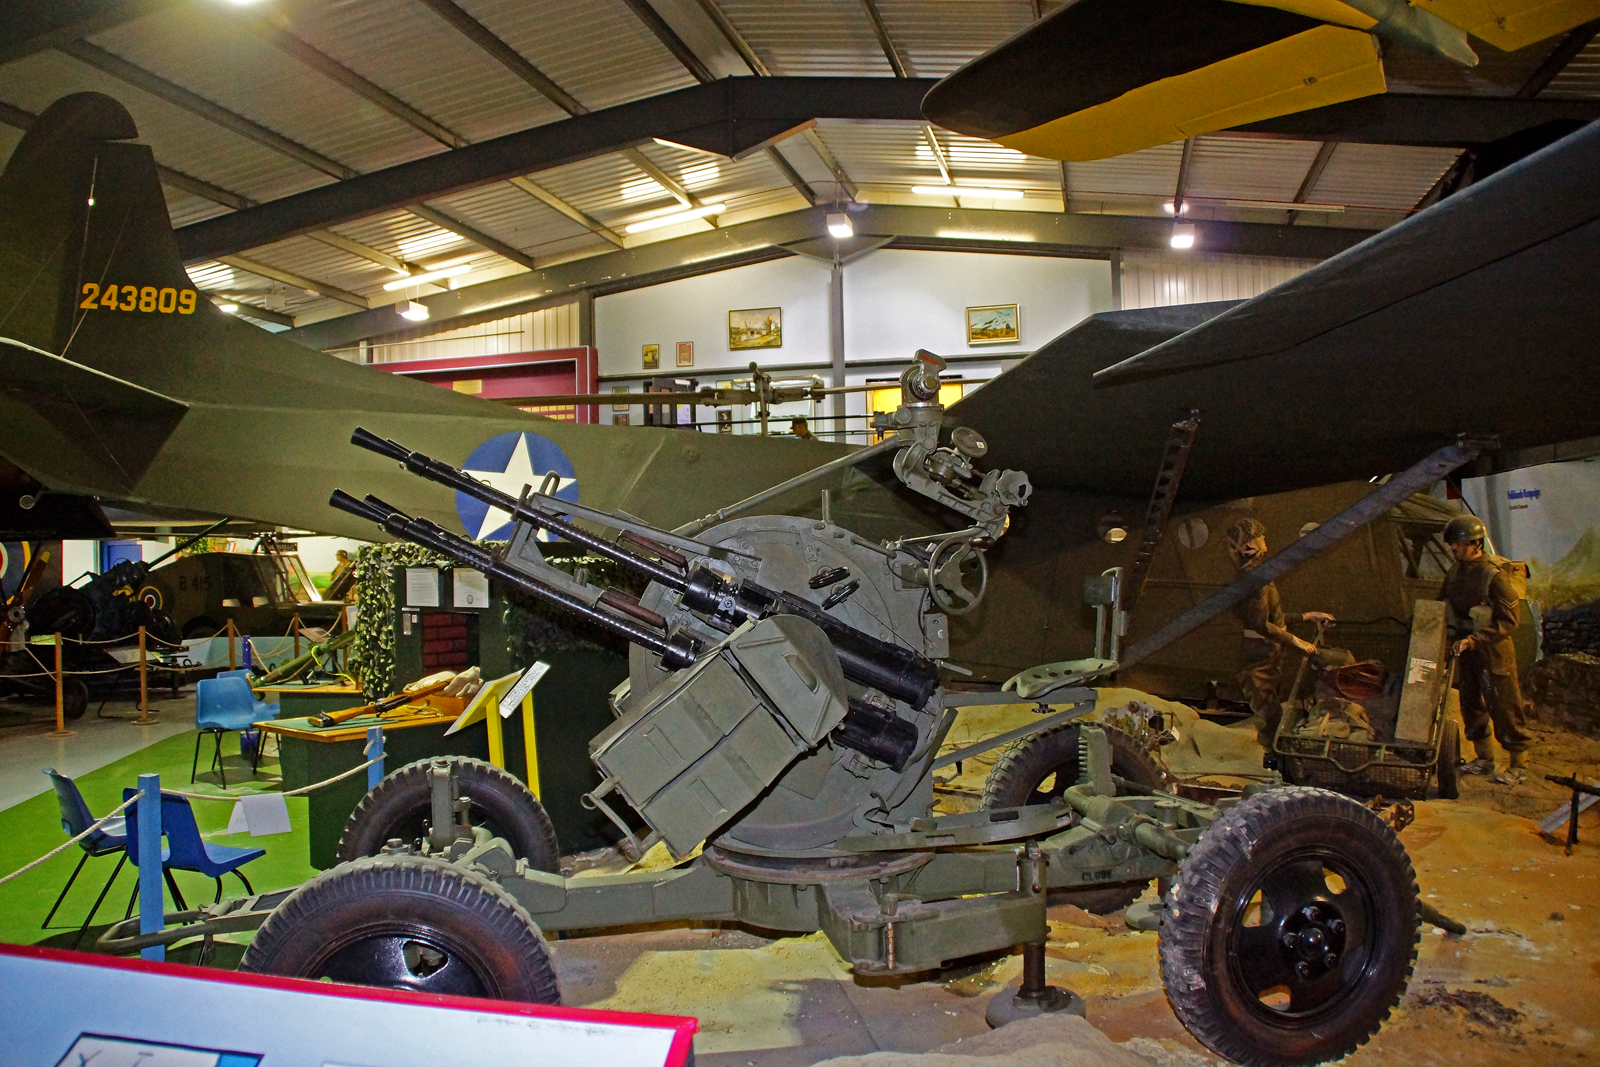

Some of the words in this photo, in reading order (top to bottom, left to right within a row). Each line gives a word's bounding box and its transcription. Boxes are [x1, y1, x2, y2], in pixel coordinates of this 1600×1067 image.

[80, 282, 197, 315] 243809
[179, 575, 188, 591] B
[191, 575, 213, 592] 415
